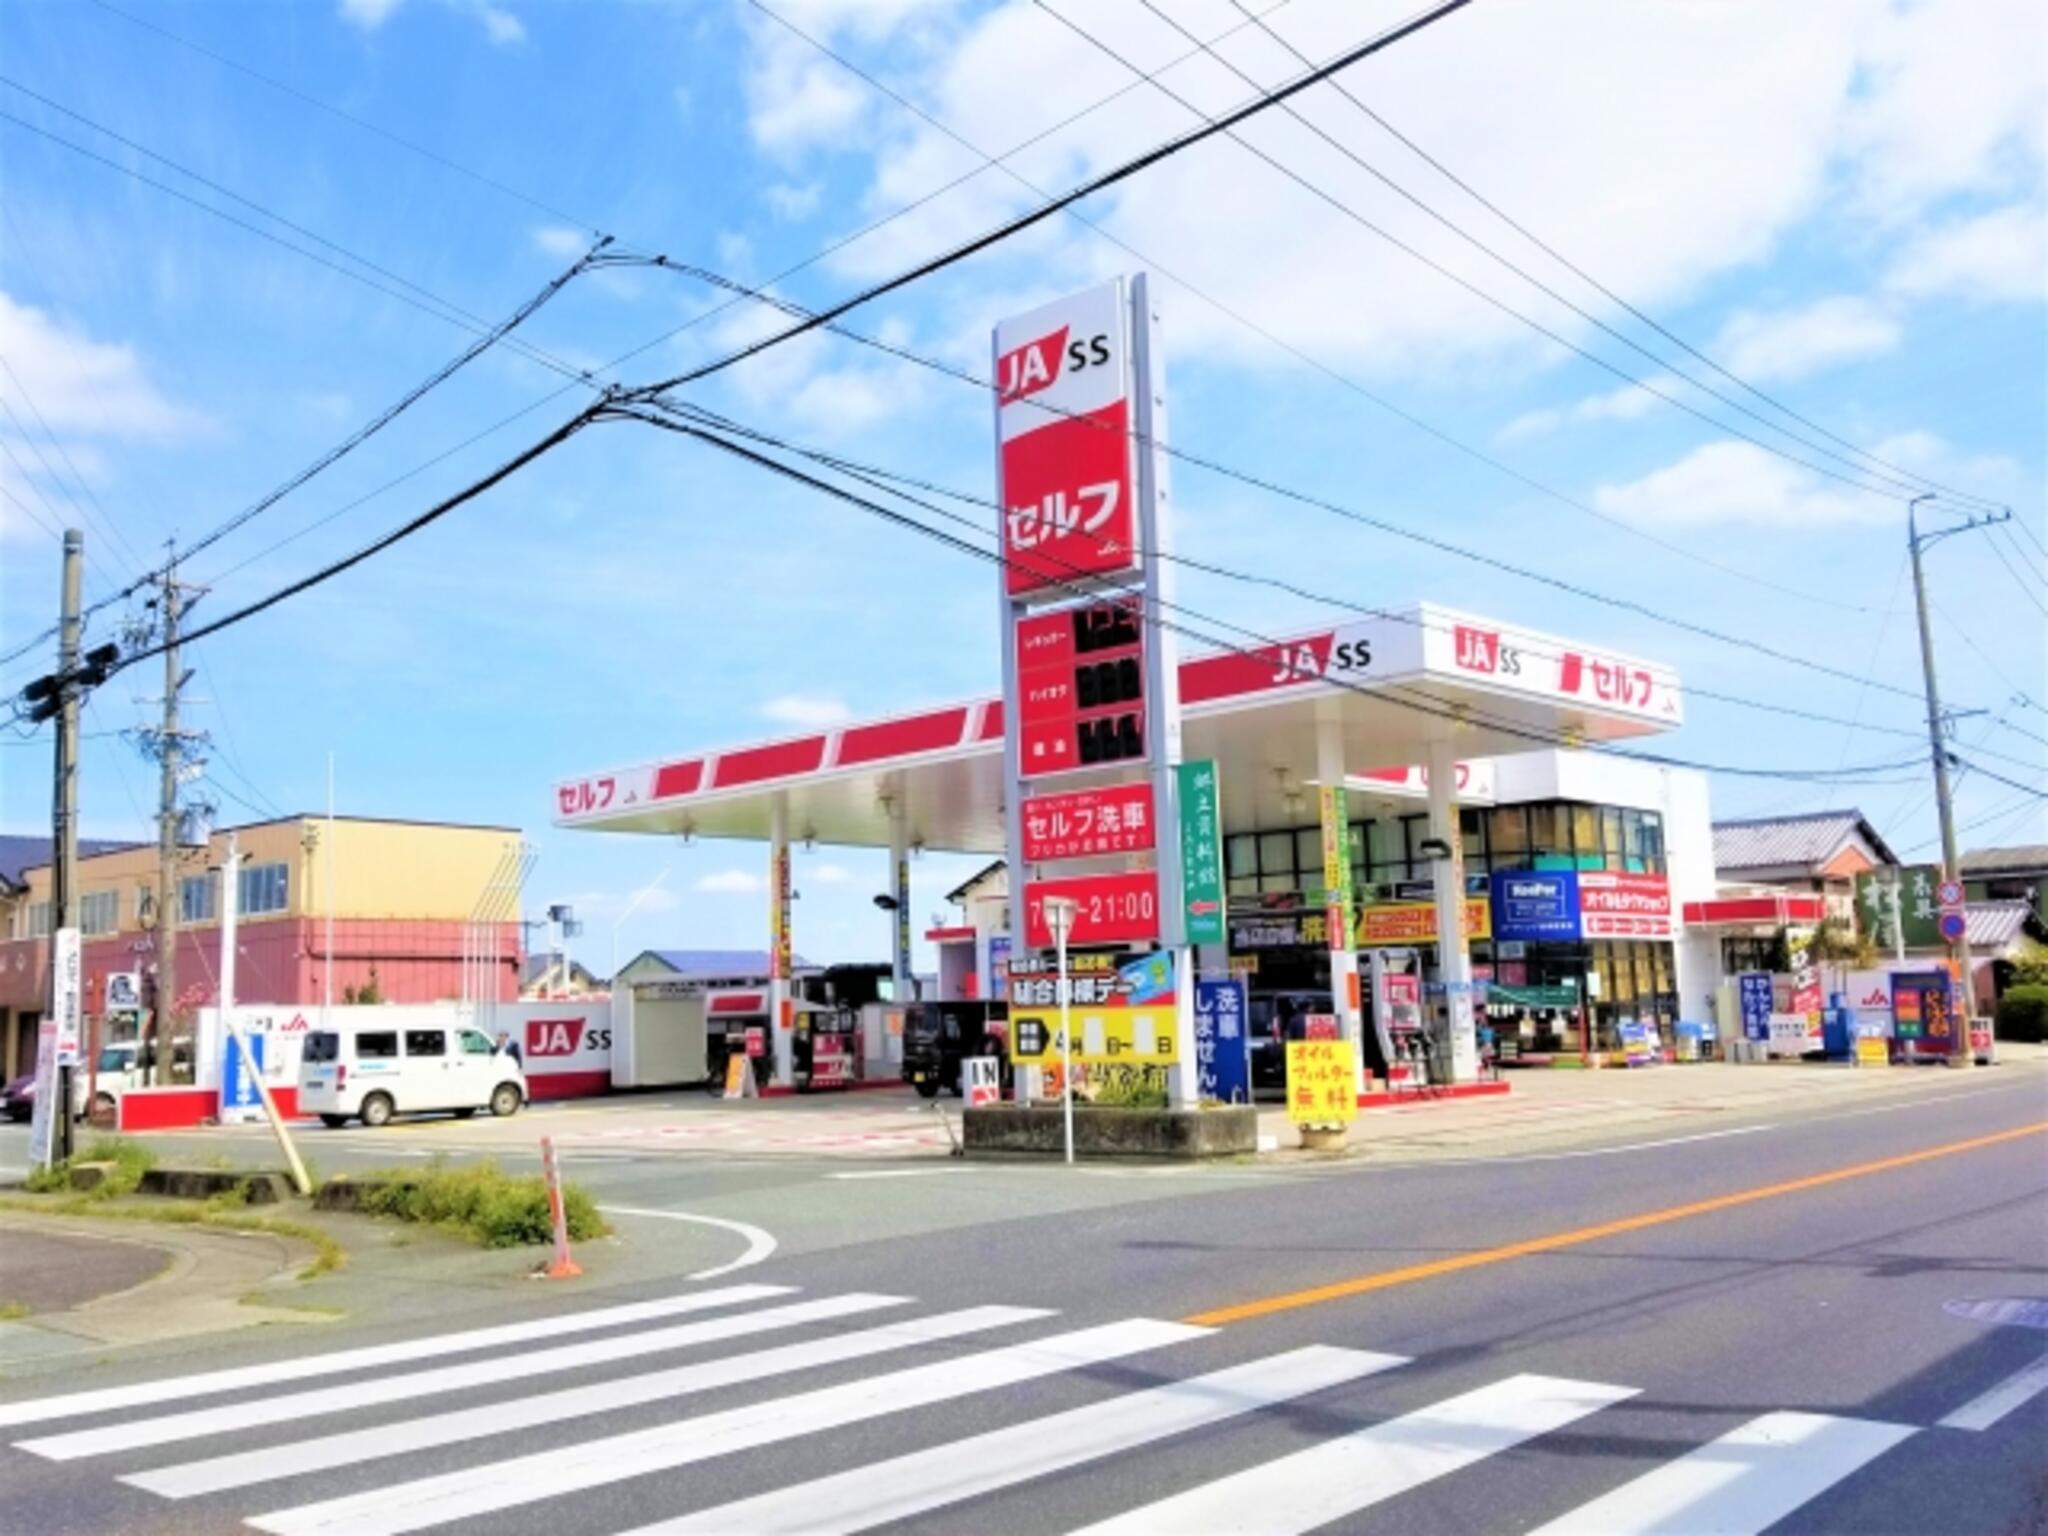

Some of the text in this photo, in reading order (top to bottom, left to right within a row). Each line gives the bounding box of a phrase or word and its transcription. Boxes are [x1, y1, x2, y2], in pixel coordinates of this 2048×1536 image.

[1001, 335, 1110, 396] JA SS
[1008, 480, 1120, 550] セルフ
[1272, 641, 1370, 684] JA SS
[1459, 630, 1520, 676] JA SS
[1591, 661, 1652, 708] セルフ
[559, 777, 615, 814] セルフ
[1027, 801, 1147, 840] セルフ洗車
[1216, 986, 1240, 1038] 洗車
[531, 1025, 611, 1055] JA SS
[972, 1061, 996, 1085] IN
